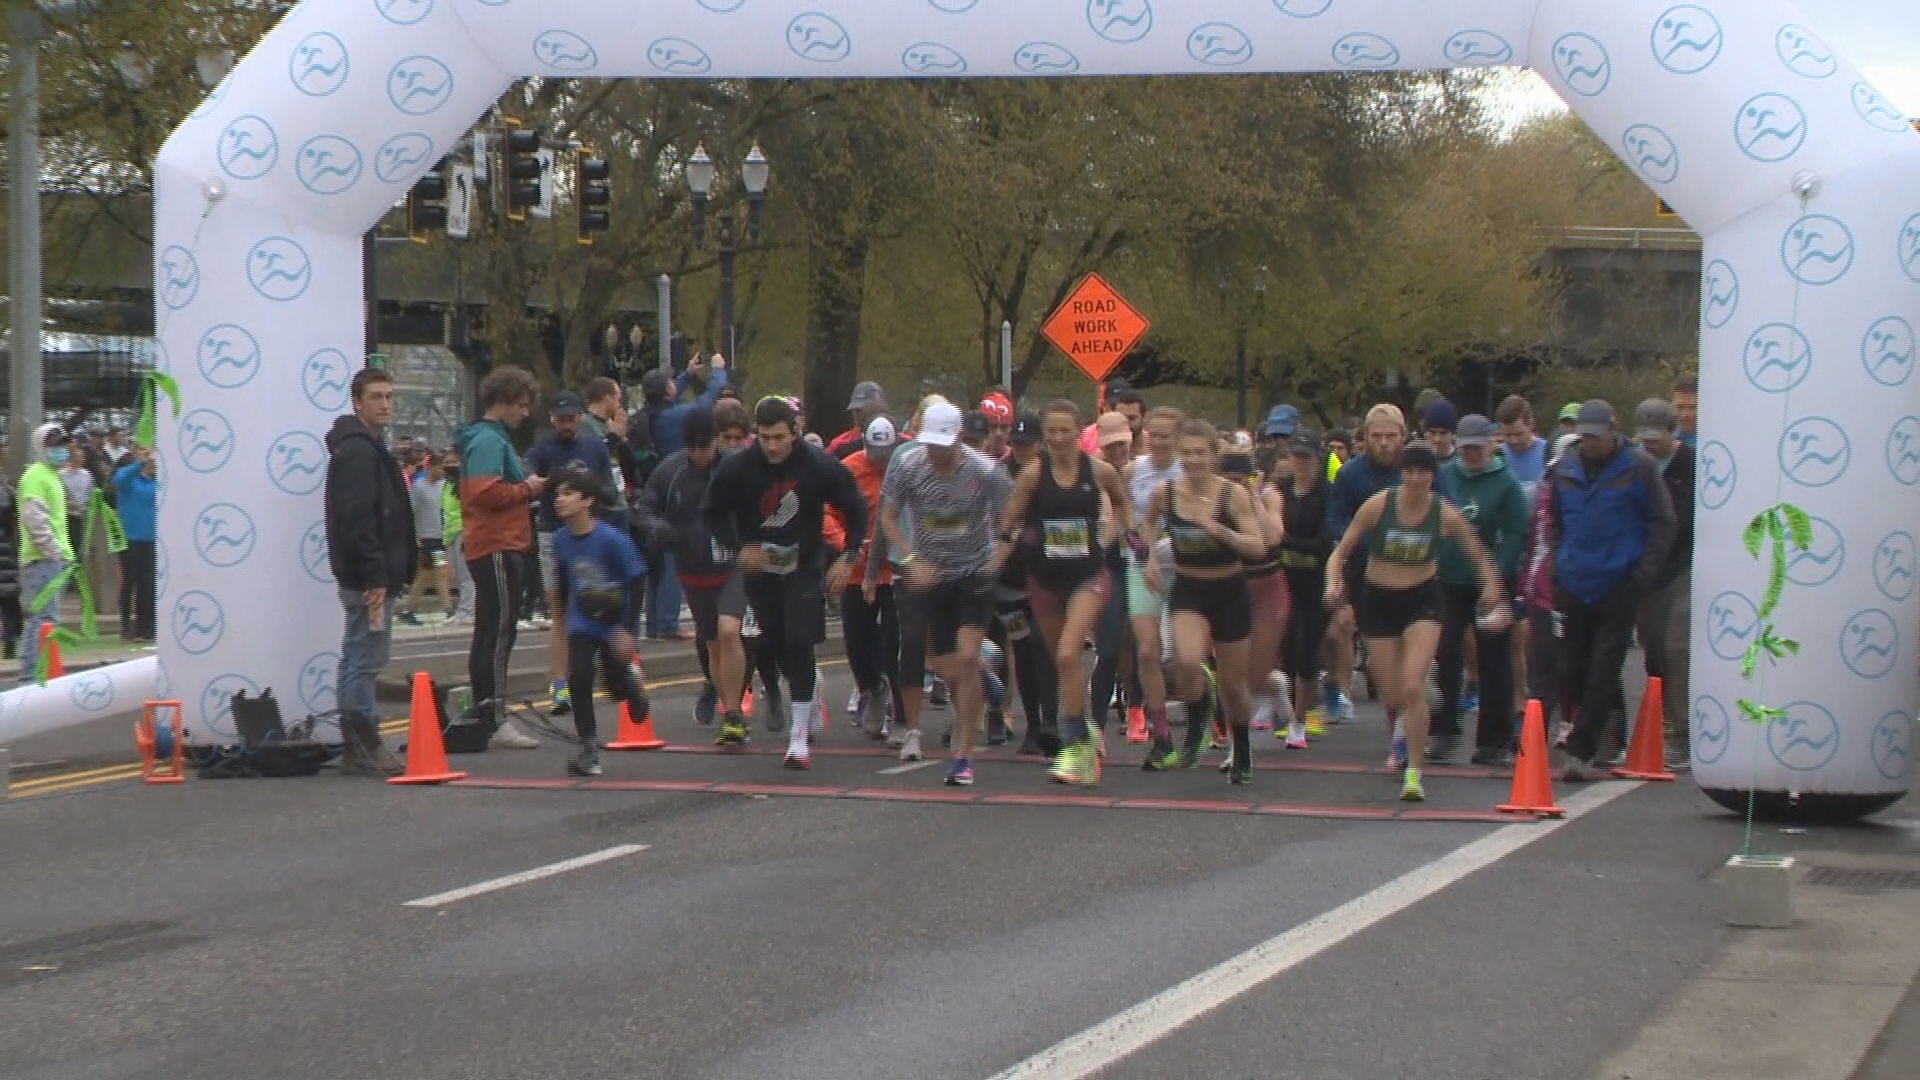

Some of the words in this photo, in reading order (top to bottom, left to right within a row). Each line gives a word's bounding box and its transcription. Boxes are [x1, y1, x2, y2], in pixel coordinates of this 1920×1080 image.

[1073, 299, 1116, 314] ROAD
[1074, 319, 1117, 334] WORK
[1071, 338, 1123, 354] AHEAD
